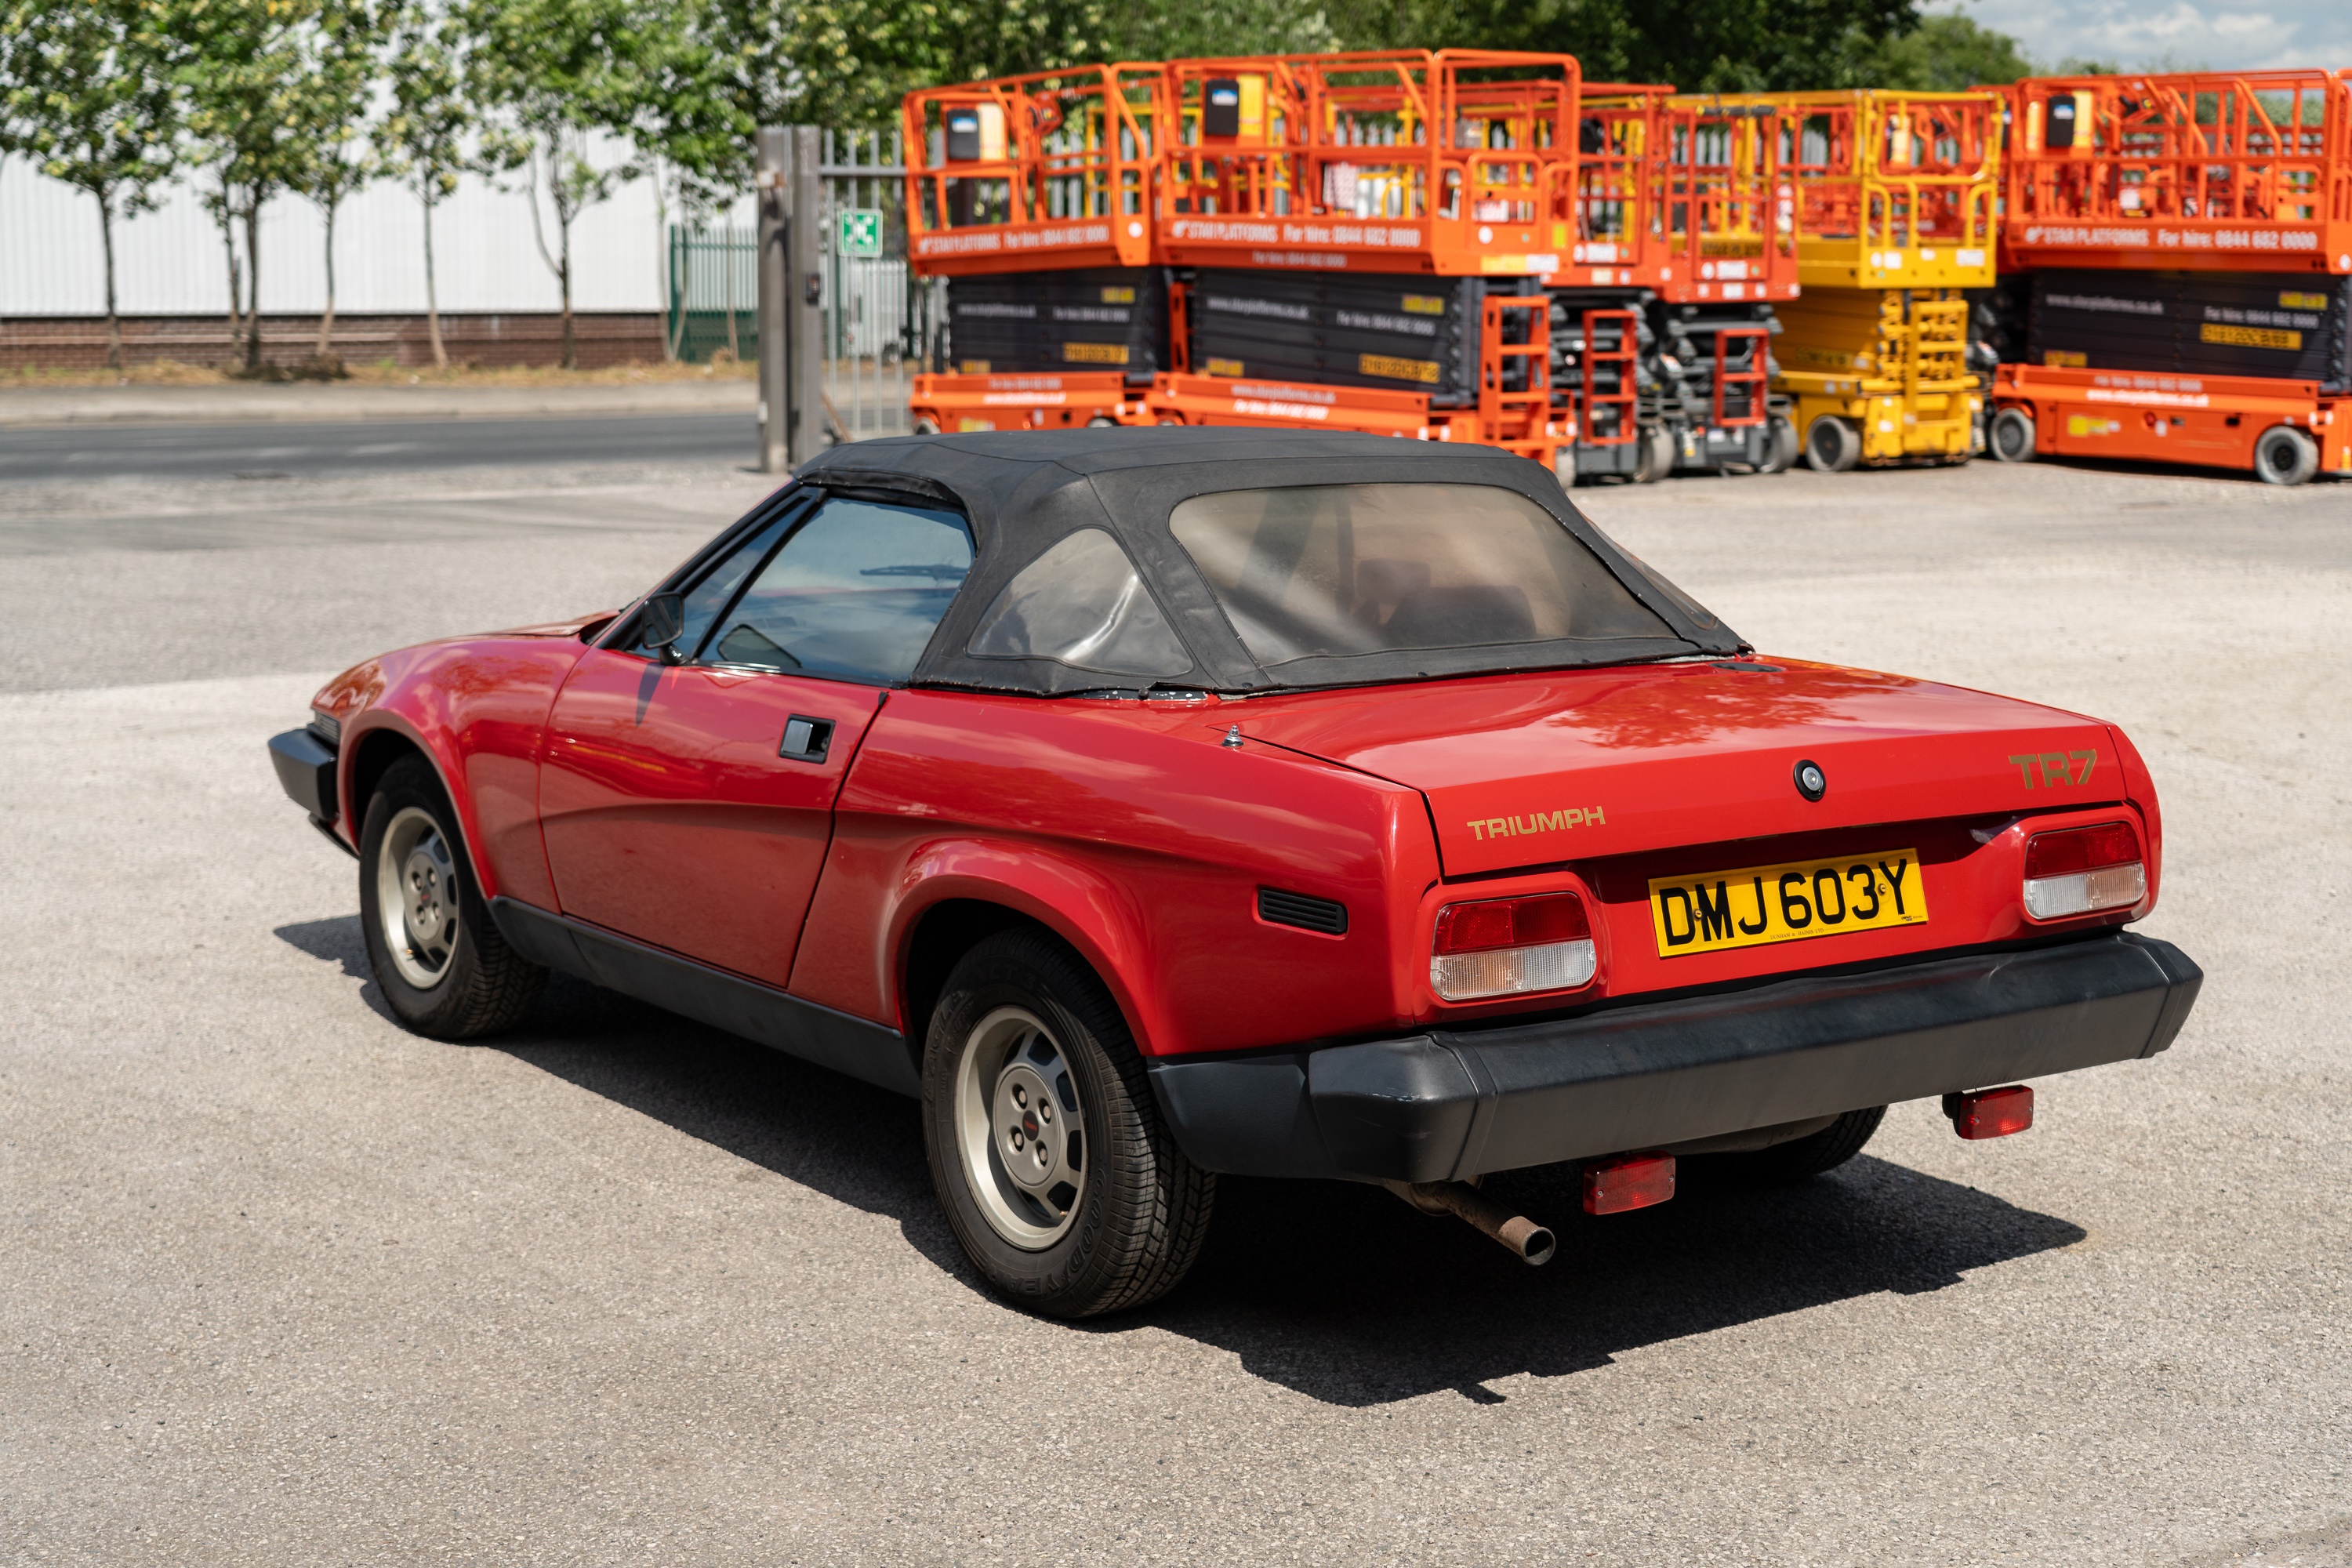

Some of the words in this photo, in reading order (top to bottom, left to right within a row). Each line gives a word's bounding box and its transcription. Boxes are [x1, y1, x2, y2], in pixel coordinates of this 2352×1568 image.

[1283, 223, 1301, 242] For
[1304, 223, 1330, 244] hire:
[1388, 228, 1421, 248] 0000
[2157, 228, 2180, 247] For
[2182, 228, 2212, 248] hire:
[2215, 230, 2249, 249] 0844
[2281, 231, 2318, 250] 0000
[2008, 749, 2097, 789] TR7
[1467, 806, 1606, 840] TRIUMPH
[1658, 876, 1768, 946] DMJ
[1778, 858, 1907, 930] 603Y
[985, 1169, 1106, 1294] GOODYEAR
